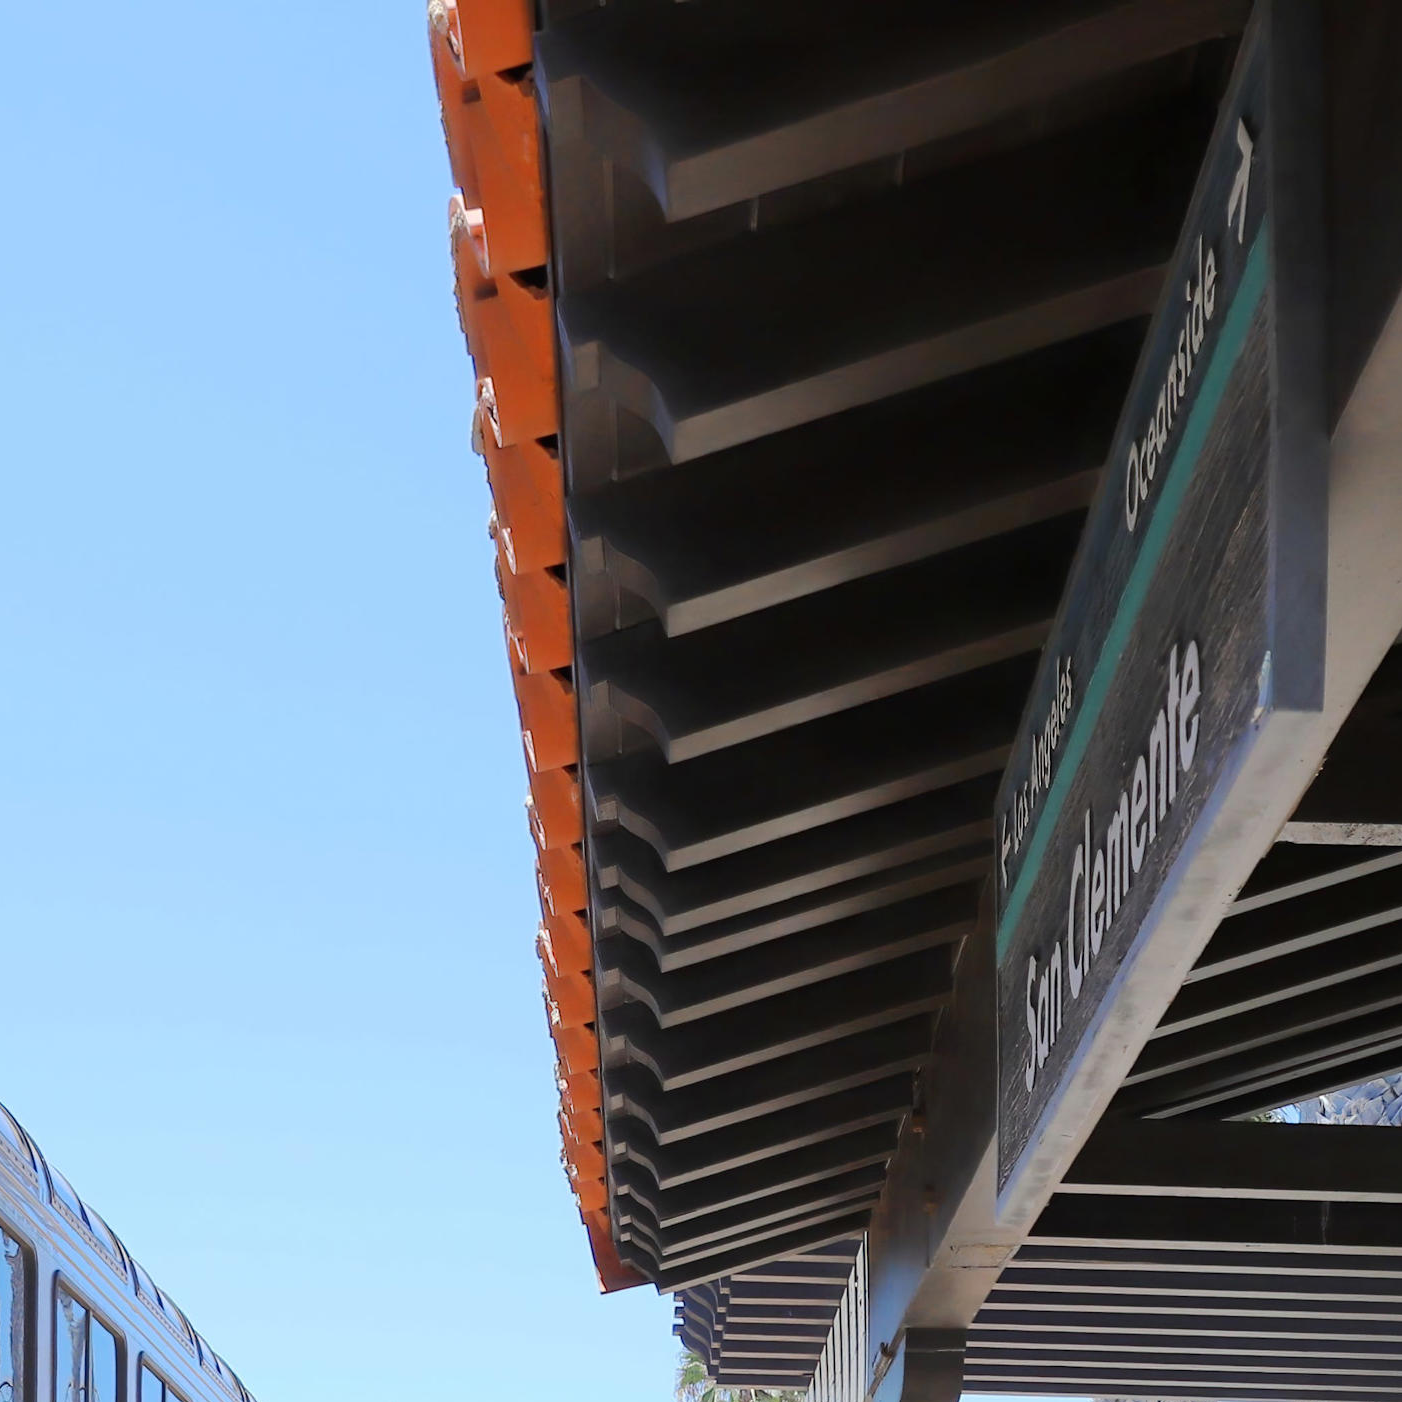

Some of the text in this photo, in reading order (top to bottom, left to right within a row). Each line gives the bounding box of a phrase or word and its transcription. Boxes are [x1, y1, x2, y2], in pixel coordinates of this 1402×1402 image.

[1126, 234, 1217, 533] Oceanside
[1013, 656, 1073, 854] Los Angeles
[1025, 640, 1202, 1093] San Clemente
